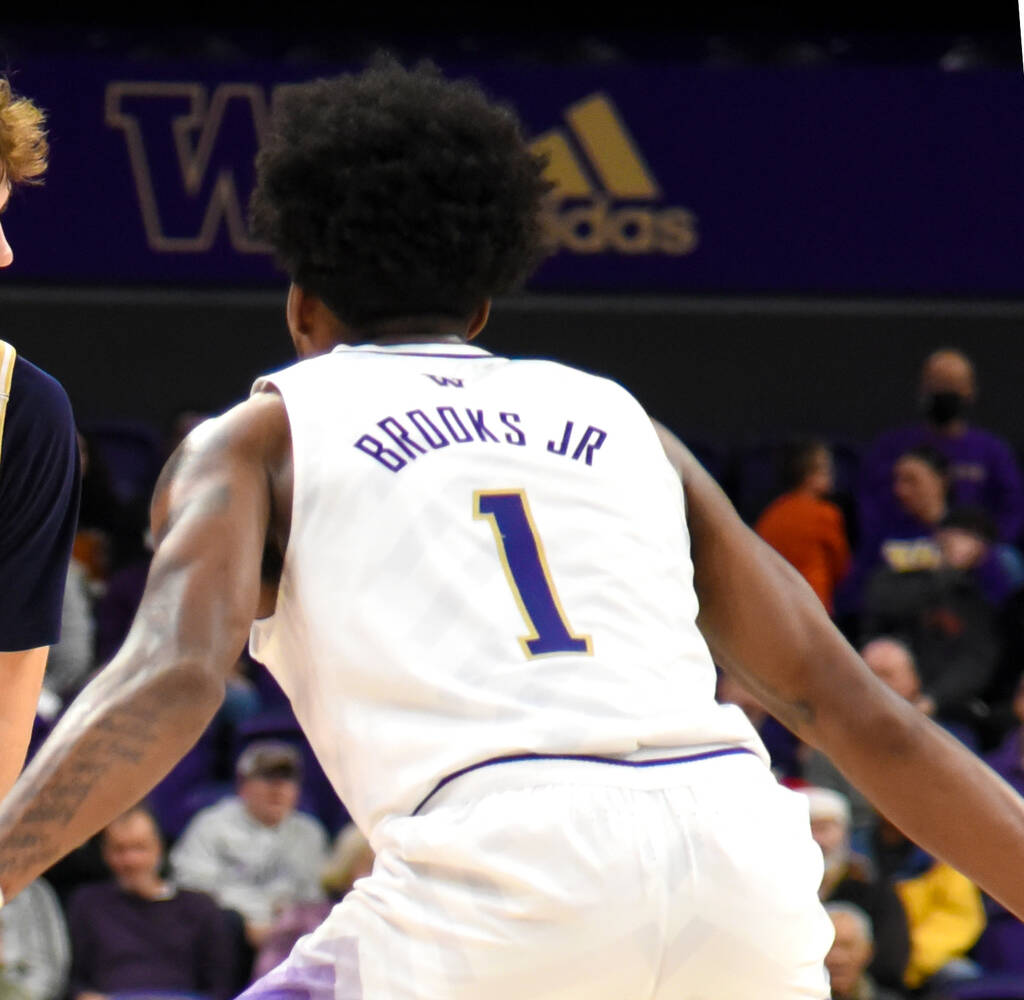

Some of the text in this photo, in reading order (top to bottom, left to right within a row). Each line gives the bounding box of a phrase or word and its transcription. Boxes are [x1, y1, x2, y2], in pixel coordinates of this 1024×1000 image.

[421, 373, 464, 388] W
[354, 406, 607, 473] BROOKS JR
[472, 488, 594, 661] 1
